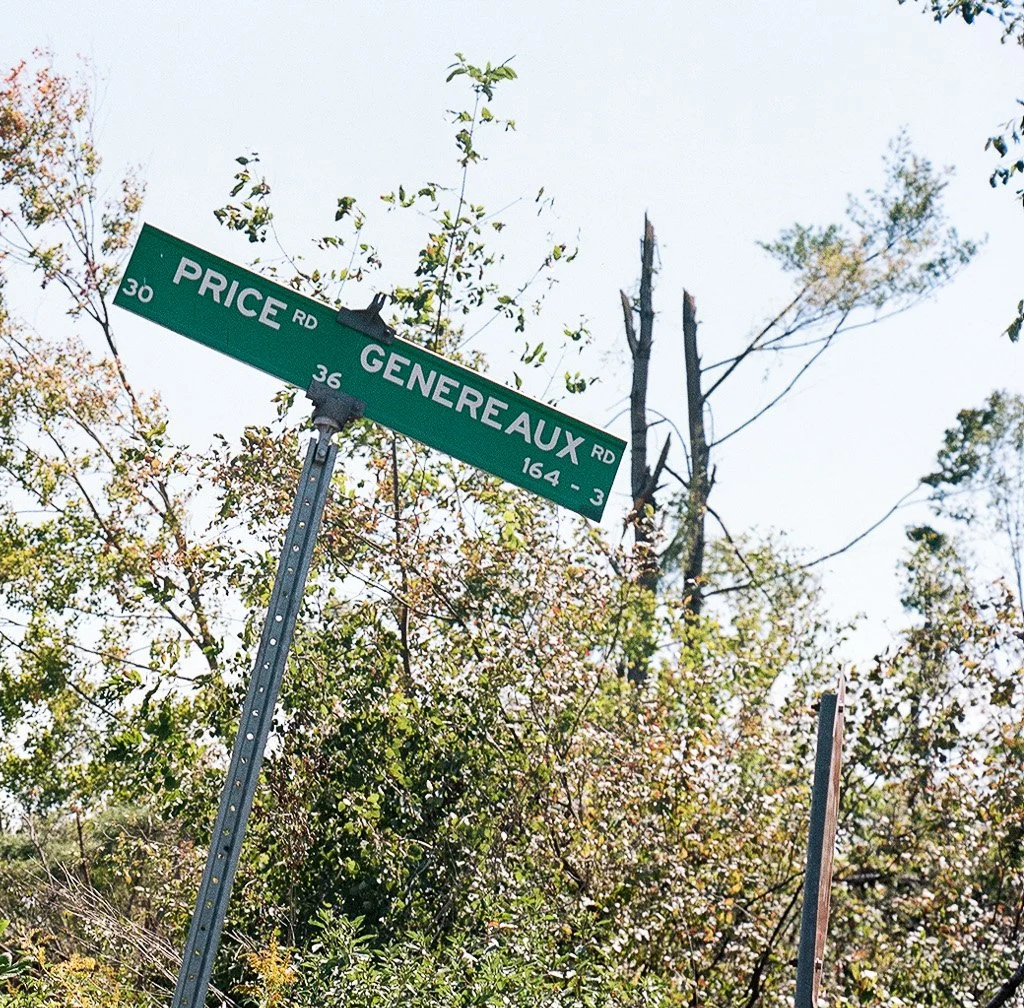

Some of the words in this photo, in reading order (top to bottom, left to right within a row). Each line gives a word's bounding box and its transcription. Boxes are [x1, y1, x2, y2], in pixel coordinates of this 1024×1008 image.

[122, 278, 154, 303] 30
[172, 256, 288, 330] PRICE
[292, 308, 318, 330] RD
[312, 364, 342, 390] 36
[360, 343, 585, 465] GENEREAUX
[590, 443, 616, 465] RD
[522, 457, 561, 487] 164
[589, 488, 605, 506] 3
